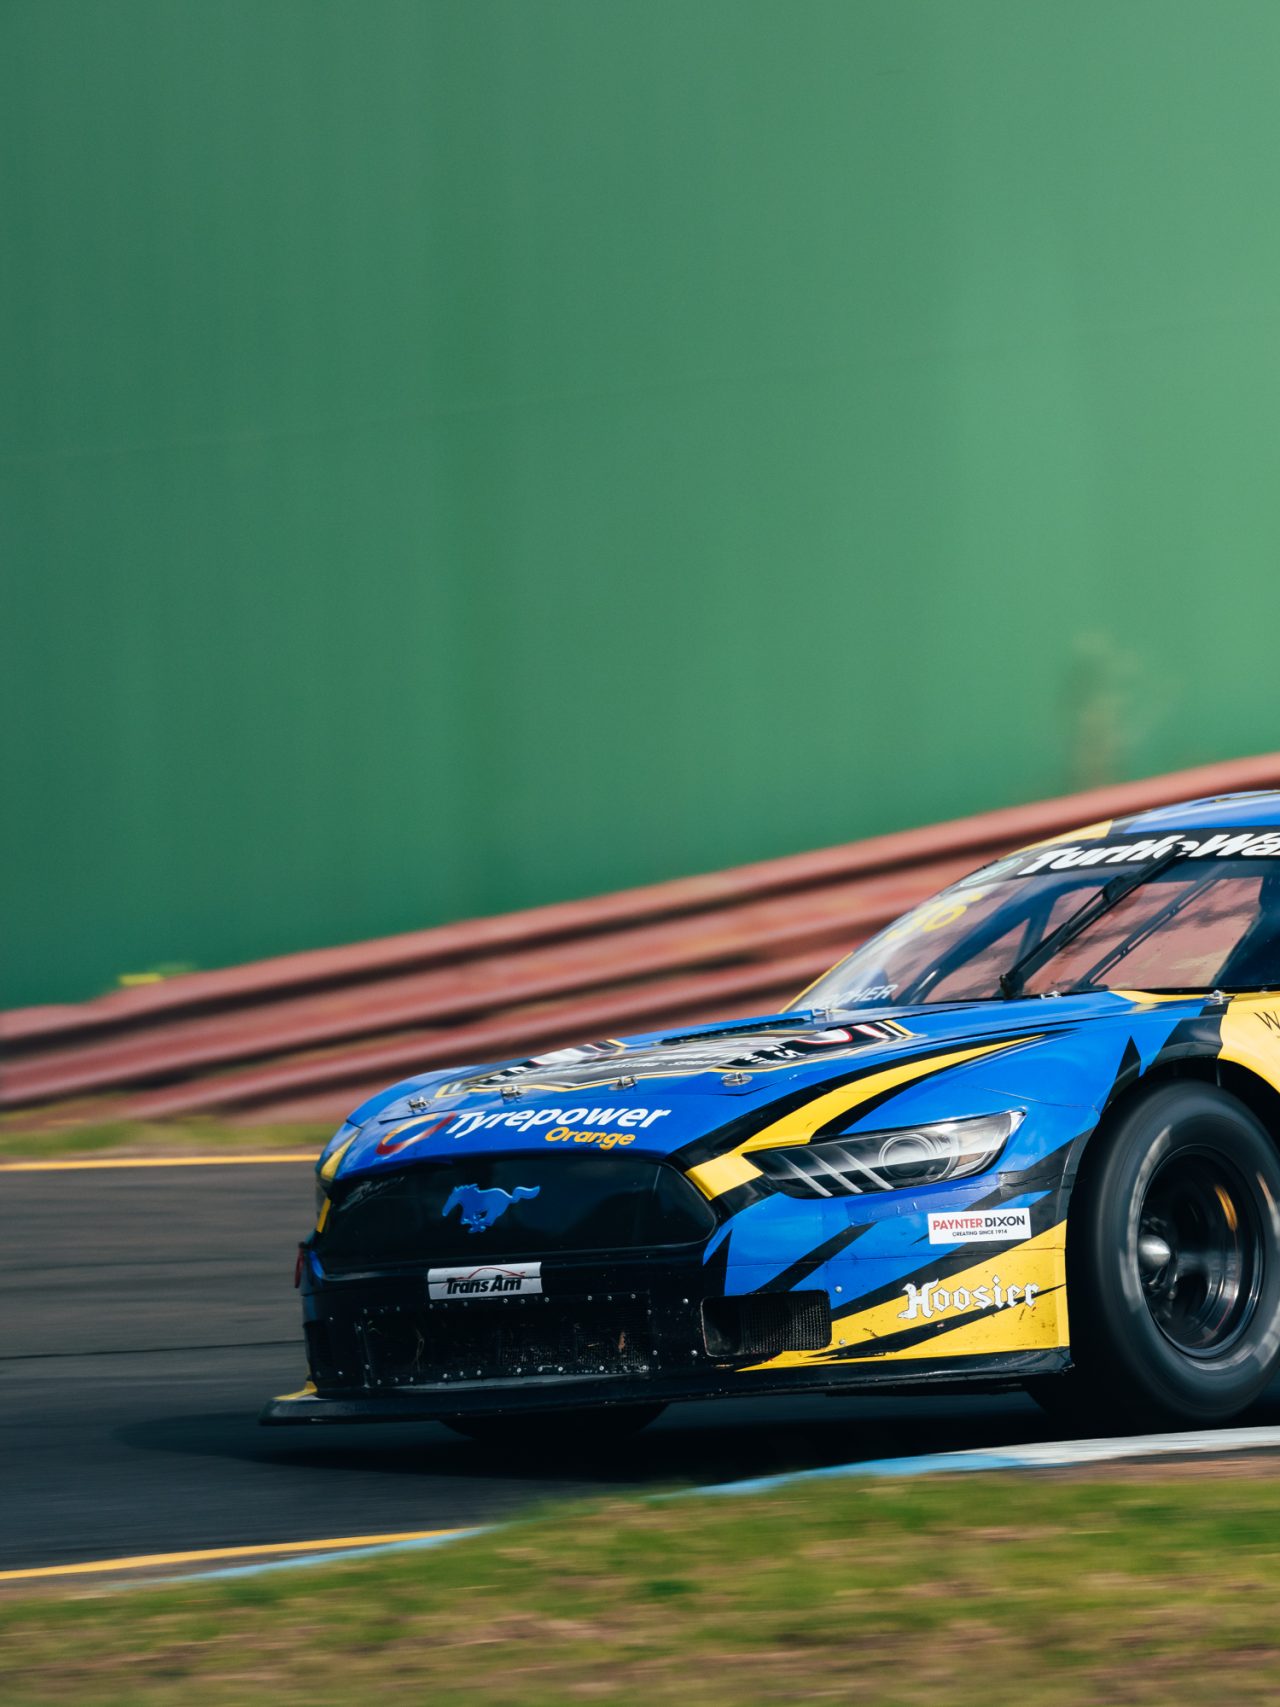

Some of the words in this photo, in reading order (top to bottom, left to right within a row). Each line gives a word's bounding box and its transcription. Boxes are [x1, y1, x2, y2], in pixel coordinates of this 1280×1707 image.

[446, 1107, 671, 1138] Tyrepower
[545, 1126, 635, 1151] Orange
[933, 1218, 982, 1230] PAYNTER
[985, 1216, 1025, 1227] DIXON
[446, 1277, 489, 1295] Trans
[490, 1274, 522, 1293] Am
[897, 1274, 1040, 1320] Hoosier
